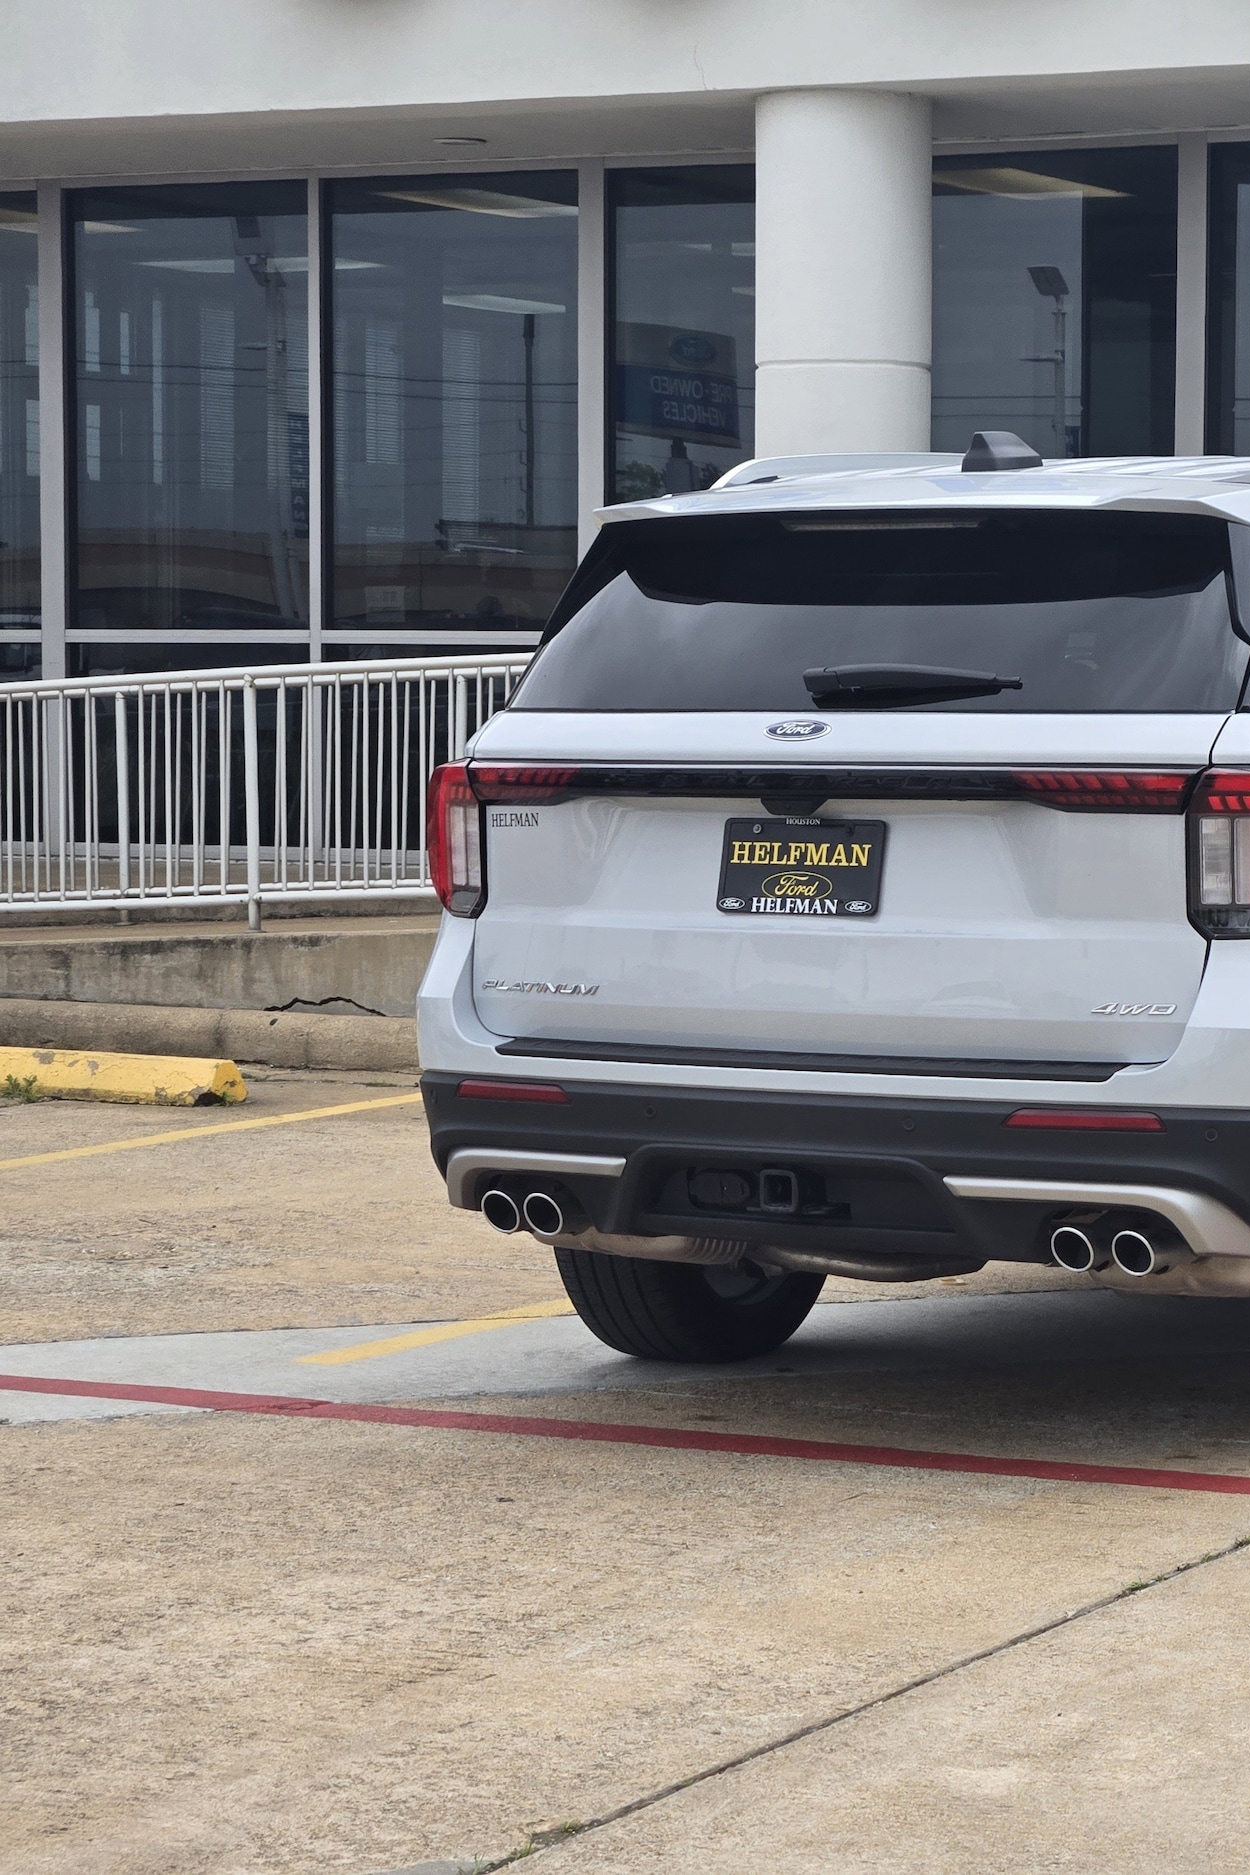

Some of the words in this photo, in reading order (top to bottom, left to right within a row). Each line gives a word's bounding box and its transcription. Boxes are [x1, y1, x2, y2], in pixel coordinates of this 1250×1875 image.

[491, 812, 539, 827] HELFMAN
[730, 841, 872, 867] HELFMAN
[751, 896, 838, 915] HELFMAN
[482, 979, 600, 996] PLATINUM
[1090, 1002, 1177, 1016] 4WD
